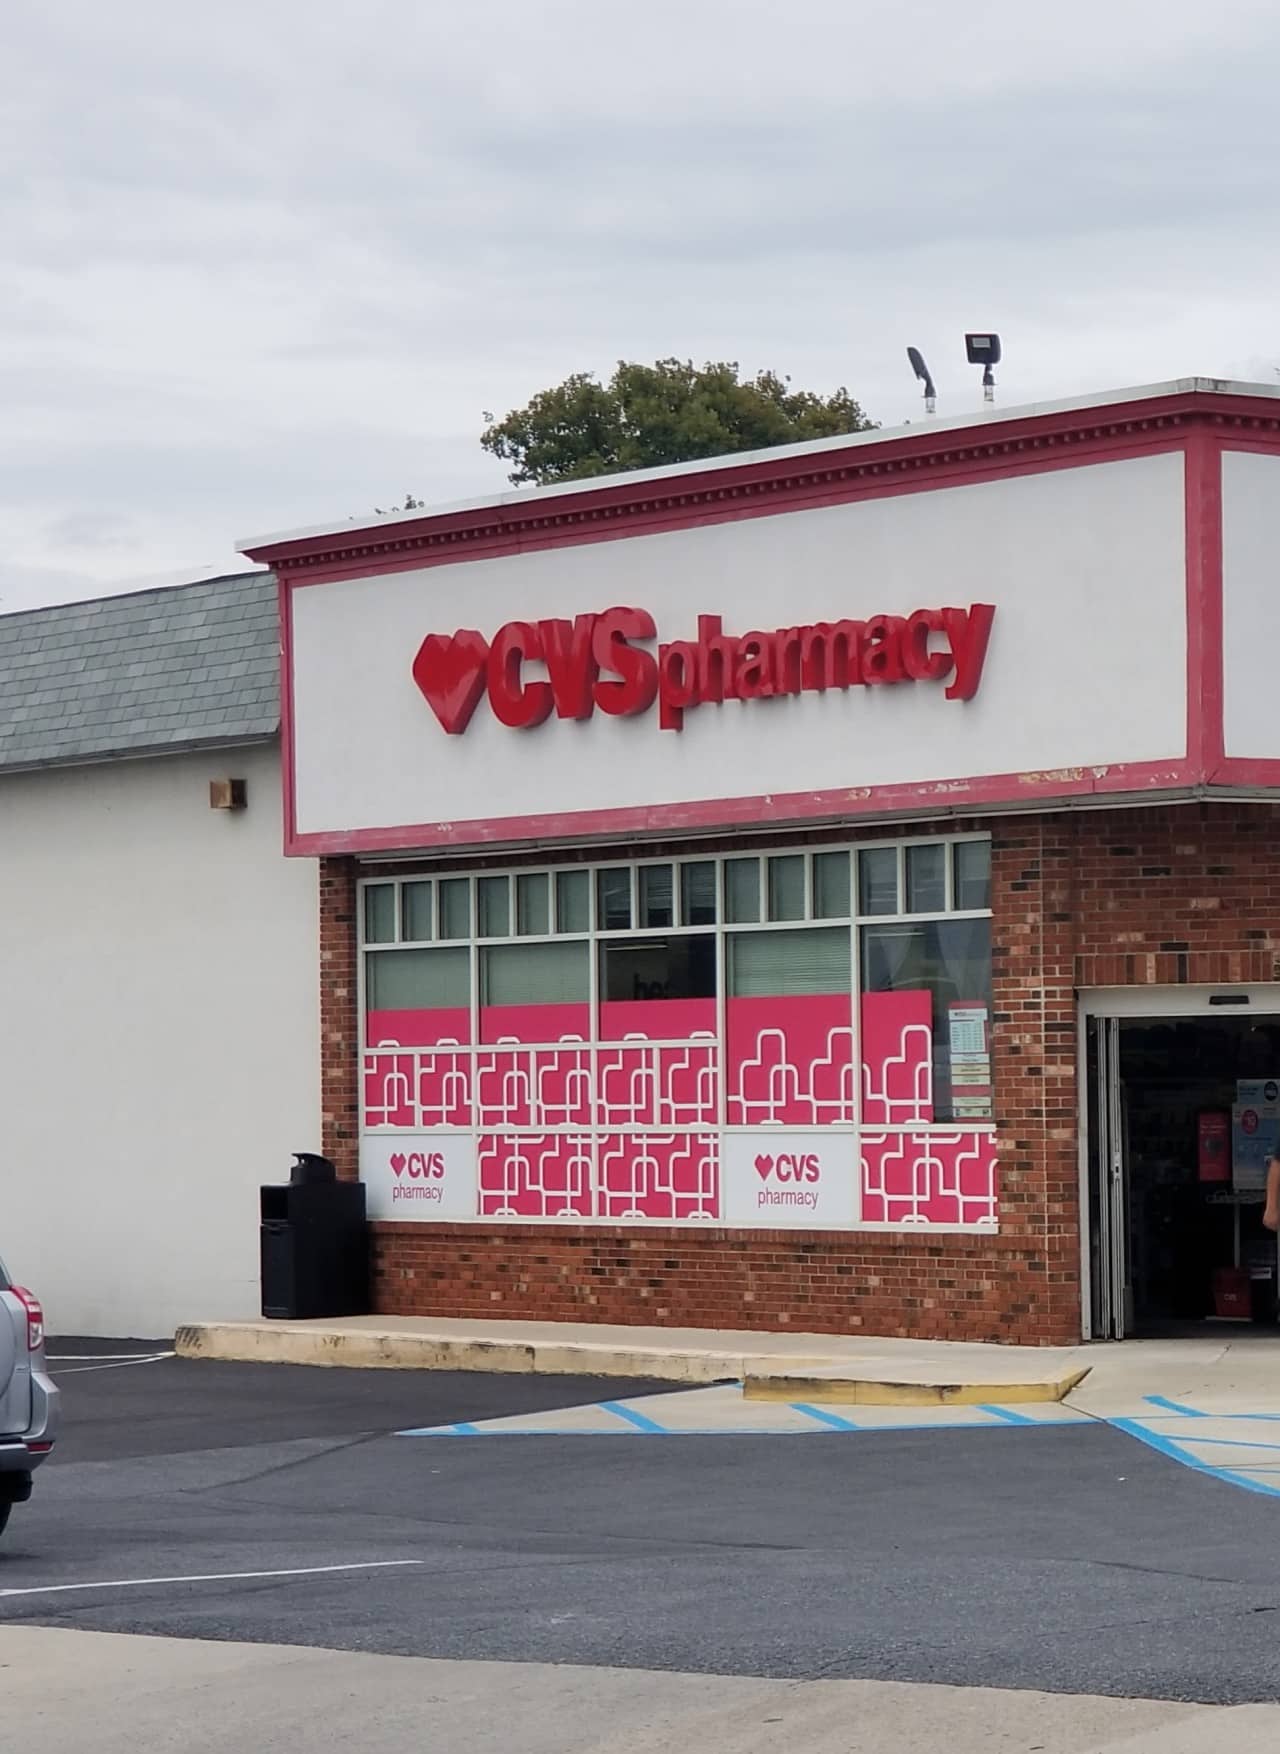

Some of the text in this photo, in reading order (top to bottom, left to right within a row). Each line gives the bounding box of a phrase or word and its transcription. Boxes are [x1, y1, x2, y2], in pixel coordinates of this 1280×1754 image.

[486, 603, 996, 731] CVS pharmacy
[407, 1153, 445, 1179] CVS
[775, 1154, 820, 1182] CVS
[392, 1183, 444, 1202] pharmacy
[757, 1187, 819, 1208] pharmacy
